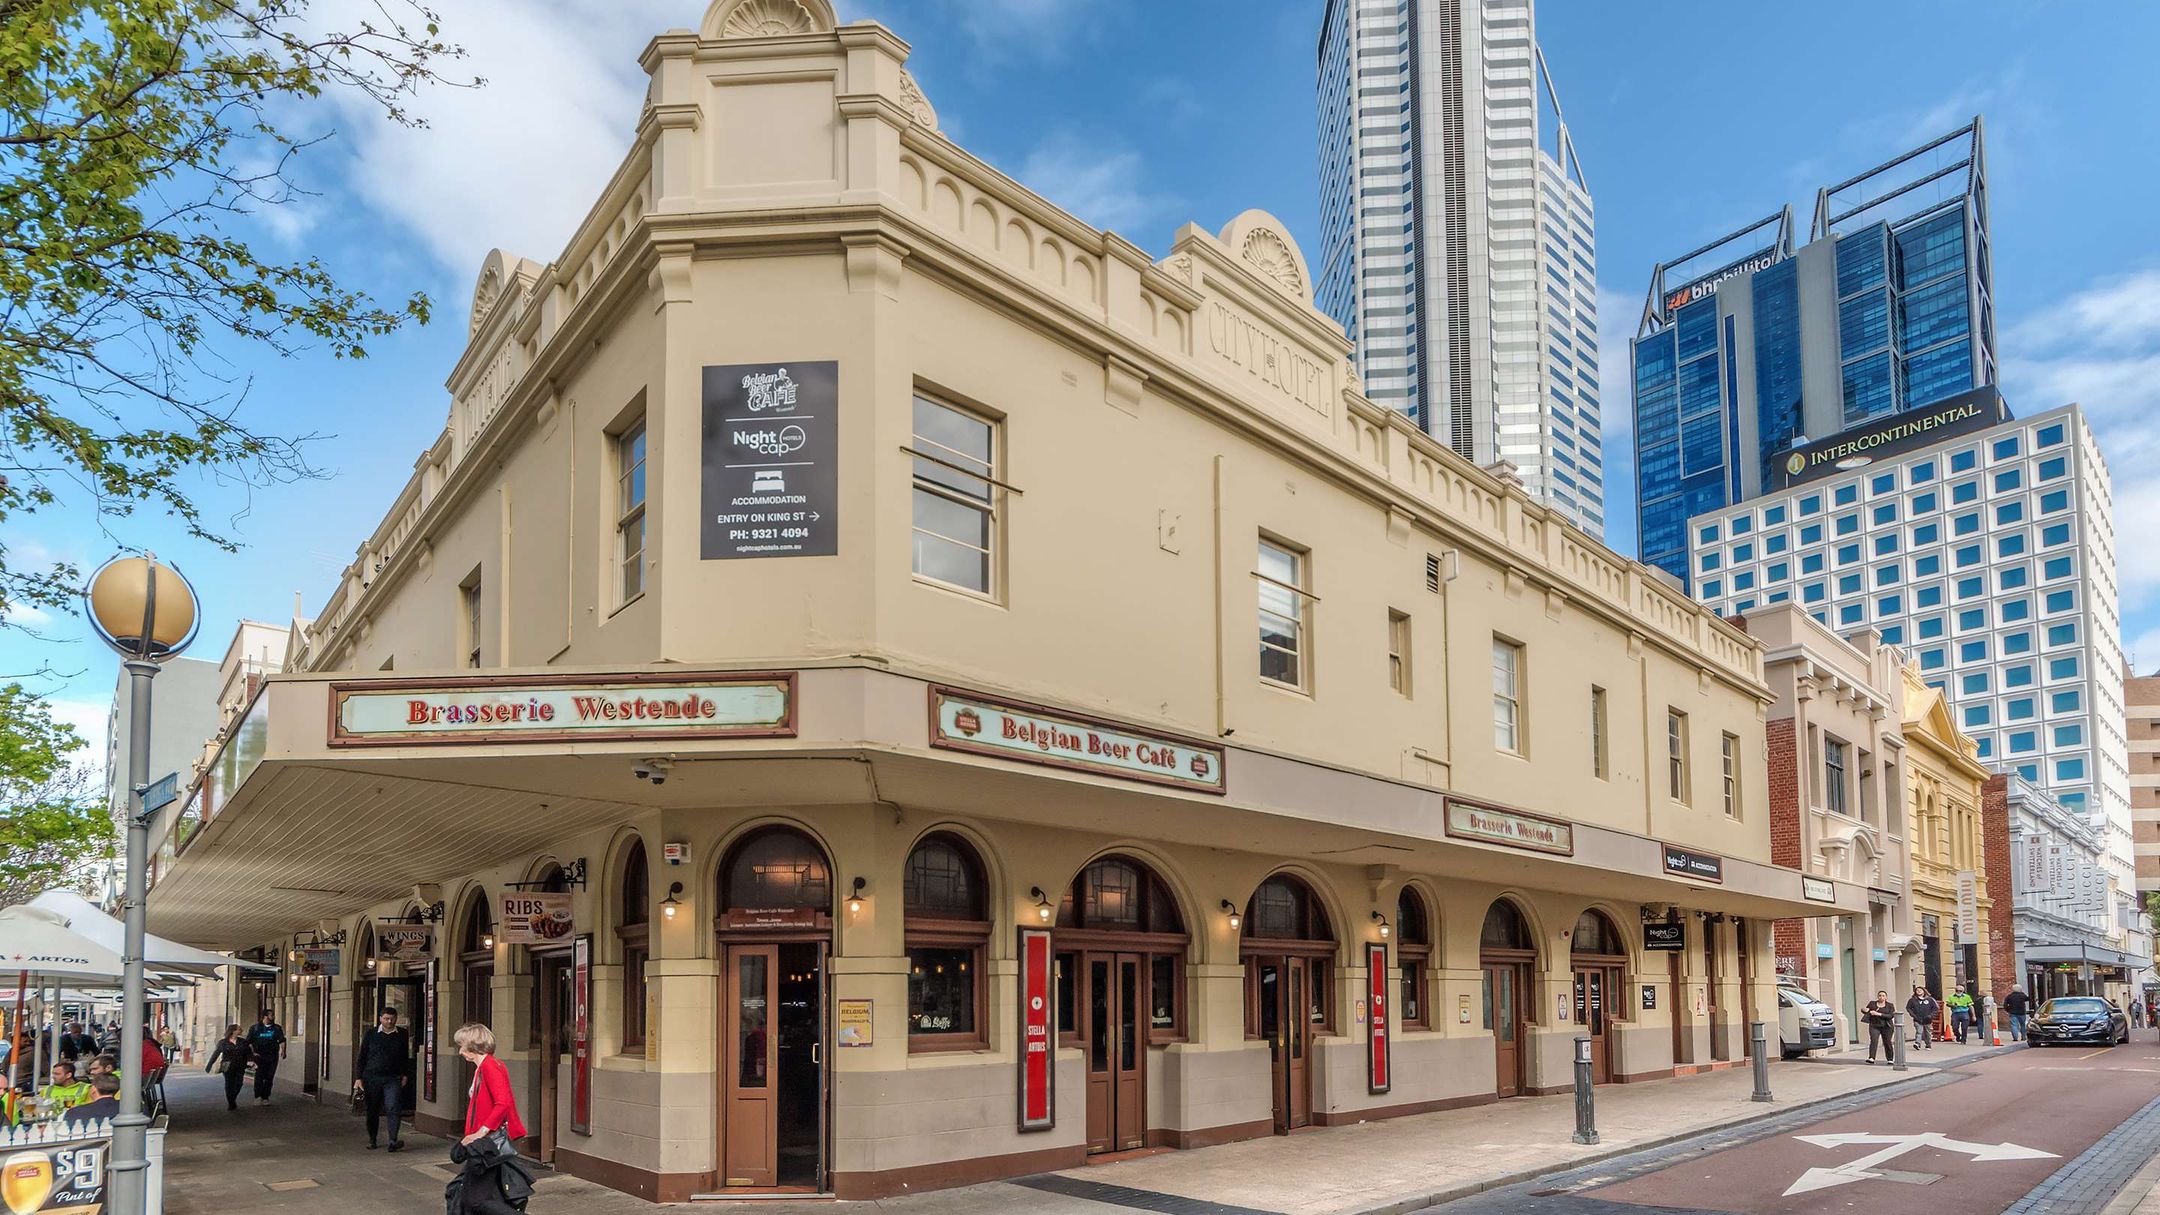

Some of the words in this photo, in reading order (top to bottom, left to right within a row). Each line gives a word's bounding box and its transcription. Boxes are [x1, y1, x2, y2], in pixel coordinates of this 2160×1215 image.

[1208, 301, 1259, 376] CITY
[1260, 331, 1329, 418] HOTEL
[742, 373, 778, 389] Belgian
[748, 383, 772, 397] Beer
[733, 430, 777, 449] Night
[759, 442, 789, 457] cap
[731, 495, 807, 506] ACCOMMODATION
[717, 514, 749, 524] ENTRY
[750, 513, 765, 523] ON
[767, 512, 791, 522] KING
[792, 512, 806, 521] ST
[729, 530, 749, 540] PH:
[751, 528, 778, 540] 9321
[780, 527, 809, 538] 4094
[406, 697, 555, 725] Brasserie
[571, 693, 717, 721] Westende
[1001, 716, 1081, 751] Belgian
[1086, 732, 1131, 761] Beer
[1135, 743, 1177, 769] Café
[1470, 813, 1513, 836] Brasserie
[1516, 822, 1554, 843] Westende
[2081, 866, 2092, 906] GUCCI
[505, 900, 543, 915] RIBS
[387, 931, 425, 940] WINGS
[28, 955, 90, 965] ARTOIS
[1027, 1024, 1046, 1036] STELLA
[56, 1147, 104, 1190] $9
[55, 1190, 83, 1203] Pint
[85, 1186, 103, 1203] of
